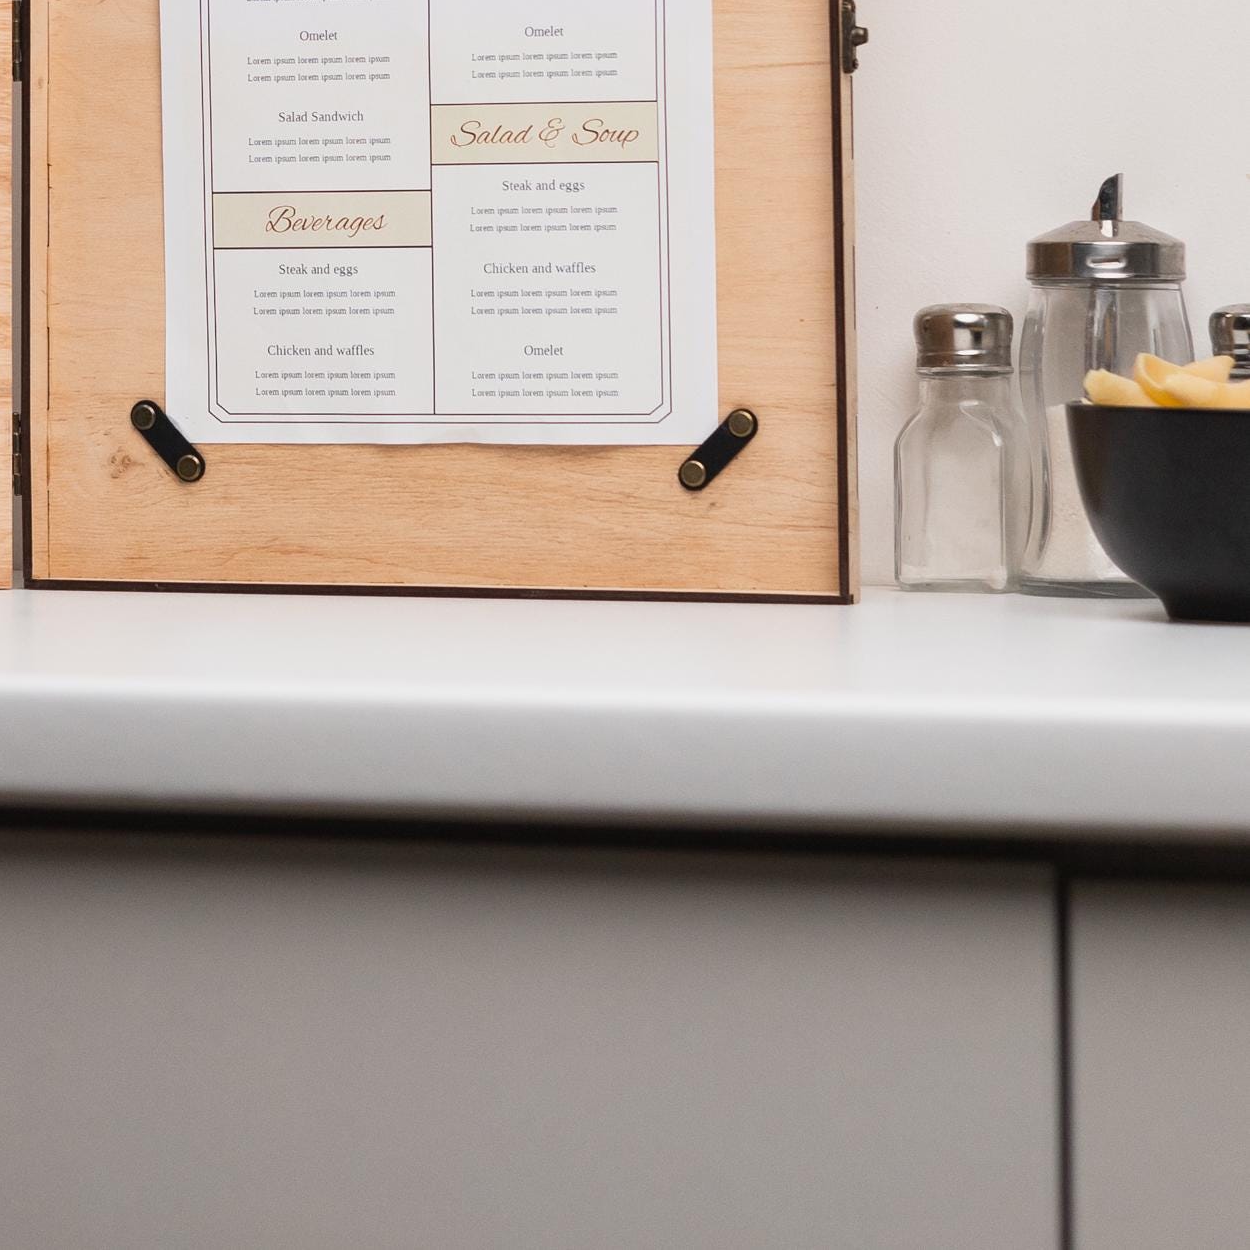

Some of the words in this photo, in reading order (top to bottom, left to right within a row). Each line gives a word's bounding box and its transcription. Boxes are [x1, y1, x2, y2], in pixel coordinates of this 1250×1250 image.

[299, 29, 338, 42] Omelet
[524, 25, 564, 38] Omelet
[247, 56, 272, 66] Lorem
[273, 58, 296, 67] ipsum
[297, 56, 319, 64] lorem
[320, 57, 343, 66] ipsum
[344, 55, 367, 63] lorem
[368, 56, 391, 65] ipsum
[247, 73, 272, 83] Lorem
[273, 75, 296, 84] ipsum
[297, 73, 320, 82] lorem
[321, 74, 344, 83] ipsum
[345, 72, 367, 81] lorem
[368, 73, 391, 82] ipsum
[471, 70, 497, 79] Lorem
[498, 71, 521, 80] ipsum
[522, 69, 545, 78] lorem
[546, 70, 569, 79] ipsum
[570, 68, 593, 77] lorem
[595, 69, 618, 78] ipsum
[278, 110, 308, 123] Salad
[311, 110, 364, 122] Sandwich
[450, 121, 533, 147] Salad
[539, 118, 565, 148] &
[572, 119, 639, 149] Soup
[248, 137, 273, 146] Lorem
[274, 139, 297, 148] ipsum
[298, 137, 320, 146] lorem
[321, 138, 344, 147] ipsum
[345, 136, 367, 145] lorem
[368, 137, 391, 146] ipsum
[248, 154, 273, 163] Lorem
[274, 156, 297, 165] ipsum
[298, 154, 321, 162] lorem
[322, 155, 344, 164] ipsum
[345, 153, 367, 162] lorem
[369, 154, 391, 164] ipsum
[501, 179, 533, 192] Steak
[535, 178, 556, 191] and
[559, 182, 586, 193] eggs
[470, 206, 495, 215] Lorem
[497, 207, 519, 217] ipsum
[521, 206, 543, 214] lorem
[545, 207, 568, 216] ipsum
[570, 205, 593, 214] lorem
[594, 207, 618, 216] ipsum
[266, 205, 386, 238] Beverages
[278, 263, 308, 275] Steak
[310, 263, 330, 275] and
[333, 265, 359, 278] eggs
[483, 262, 529, 274] Chicken
[531, 261, 552, 274] and
[555, 261, 597, 274] waffles
[253, 289, 278, 299] Lorem
[279, 291, 302, 300] ipsum
[303, 289, 324, 298] lorem
[326, 291, 348, 300] ipsum
[349, 289, 372, 298] lorem
[373, 290, 396, 300] ipsum
[253, 306, 277, 316] Lorem
[278, 308, 301, 317] ipsum
[302, 306, 323, 315] lorem
[325, 308, 347, 317] ipsum
[348, 306, 371, 315] lorem
[372, 308, 395, 317] ipsum
[471, 306, 496, 315] Lorem
[497, 308, 520, 317] ipsum
[521, 306, 543, 315] lorem
[545, 307, 568, 316] ipsum
[569, 306, 593, 314] lorem
[594, 307, 618, 316] ipsum
[267, 344, 311, 356] Chicken
[314, 344, 333, 356] and
[335, 344, 375, 356] waffles
[523, 344, 564, 357] Omelet
[254, 370, 280, 379] Lorem
[281, 372, 303, 381] ipsum
[304, 370, 326, 379] lorem
[327, 372, 349, 381] ipsum
[350, 370, 372, 379] lorem
[373, 372, 396, 381] ipsum
[471, 371, 496, 380] Lorem
[498, 373, 520, 382] ipsum
[522, 371, 544, 380] lorem
[545, 372, 569, 382] ipsum
[570, 371, 593, 380] lorem
[595, 372, 619, 381] ipsum
[255, 387, 280, 396] Lorem
[281, 389, 304, 398] ipsum
[304, 388, 326, 397] lorem
[327, 389, 349, 398] ipsum
[350, 388, 372, 397] lorem
[373, 389, 396, 399] ipsum
[471, 388, 496, 397] Lorem
[498, 390, 521, 399] ipsum
[522, 388, 544, 397] lorem
[546, 390, 569, 399] ipsum
[570, 388, 594, 397] lorem
[595, 390, 619, 399] ipsum
